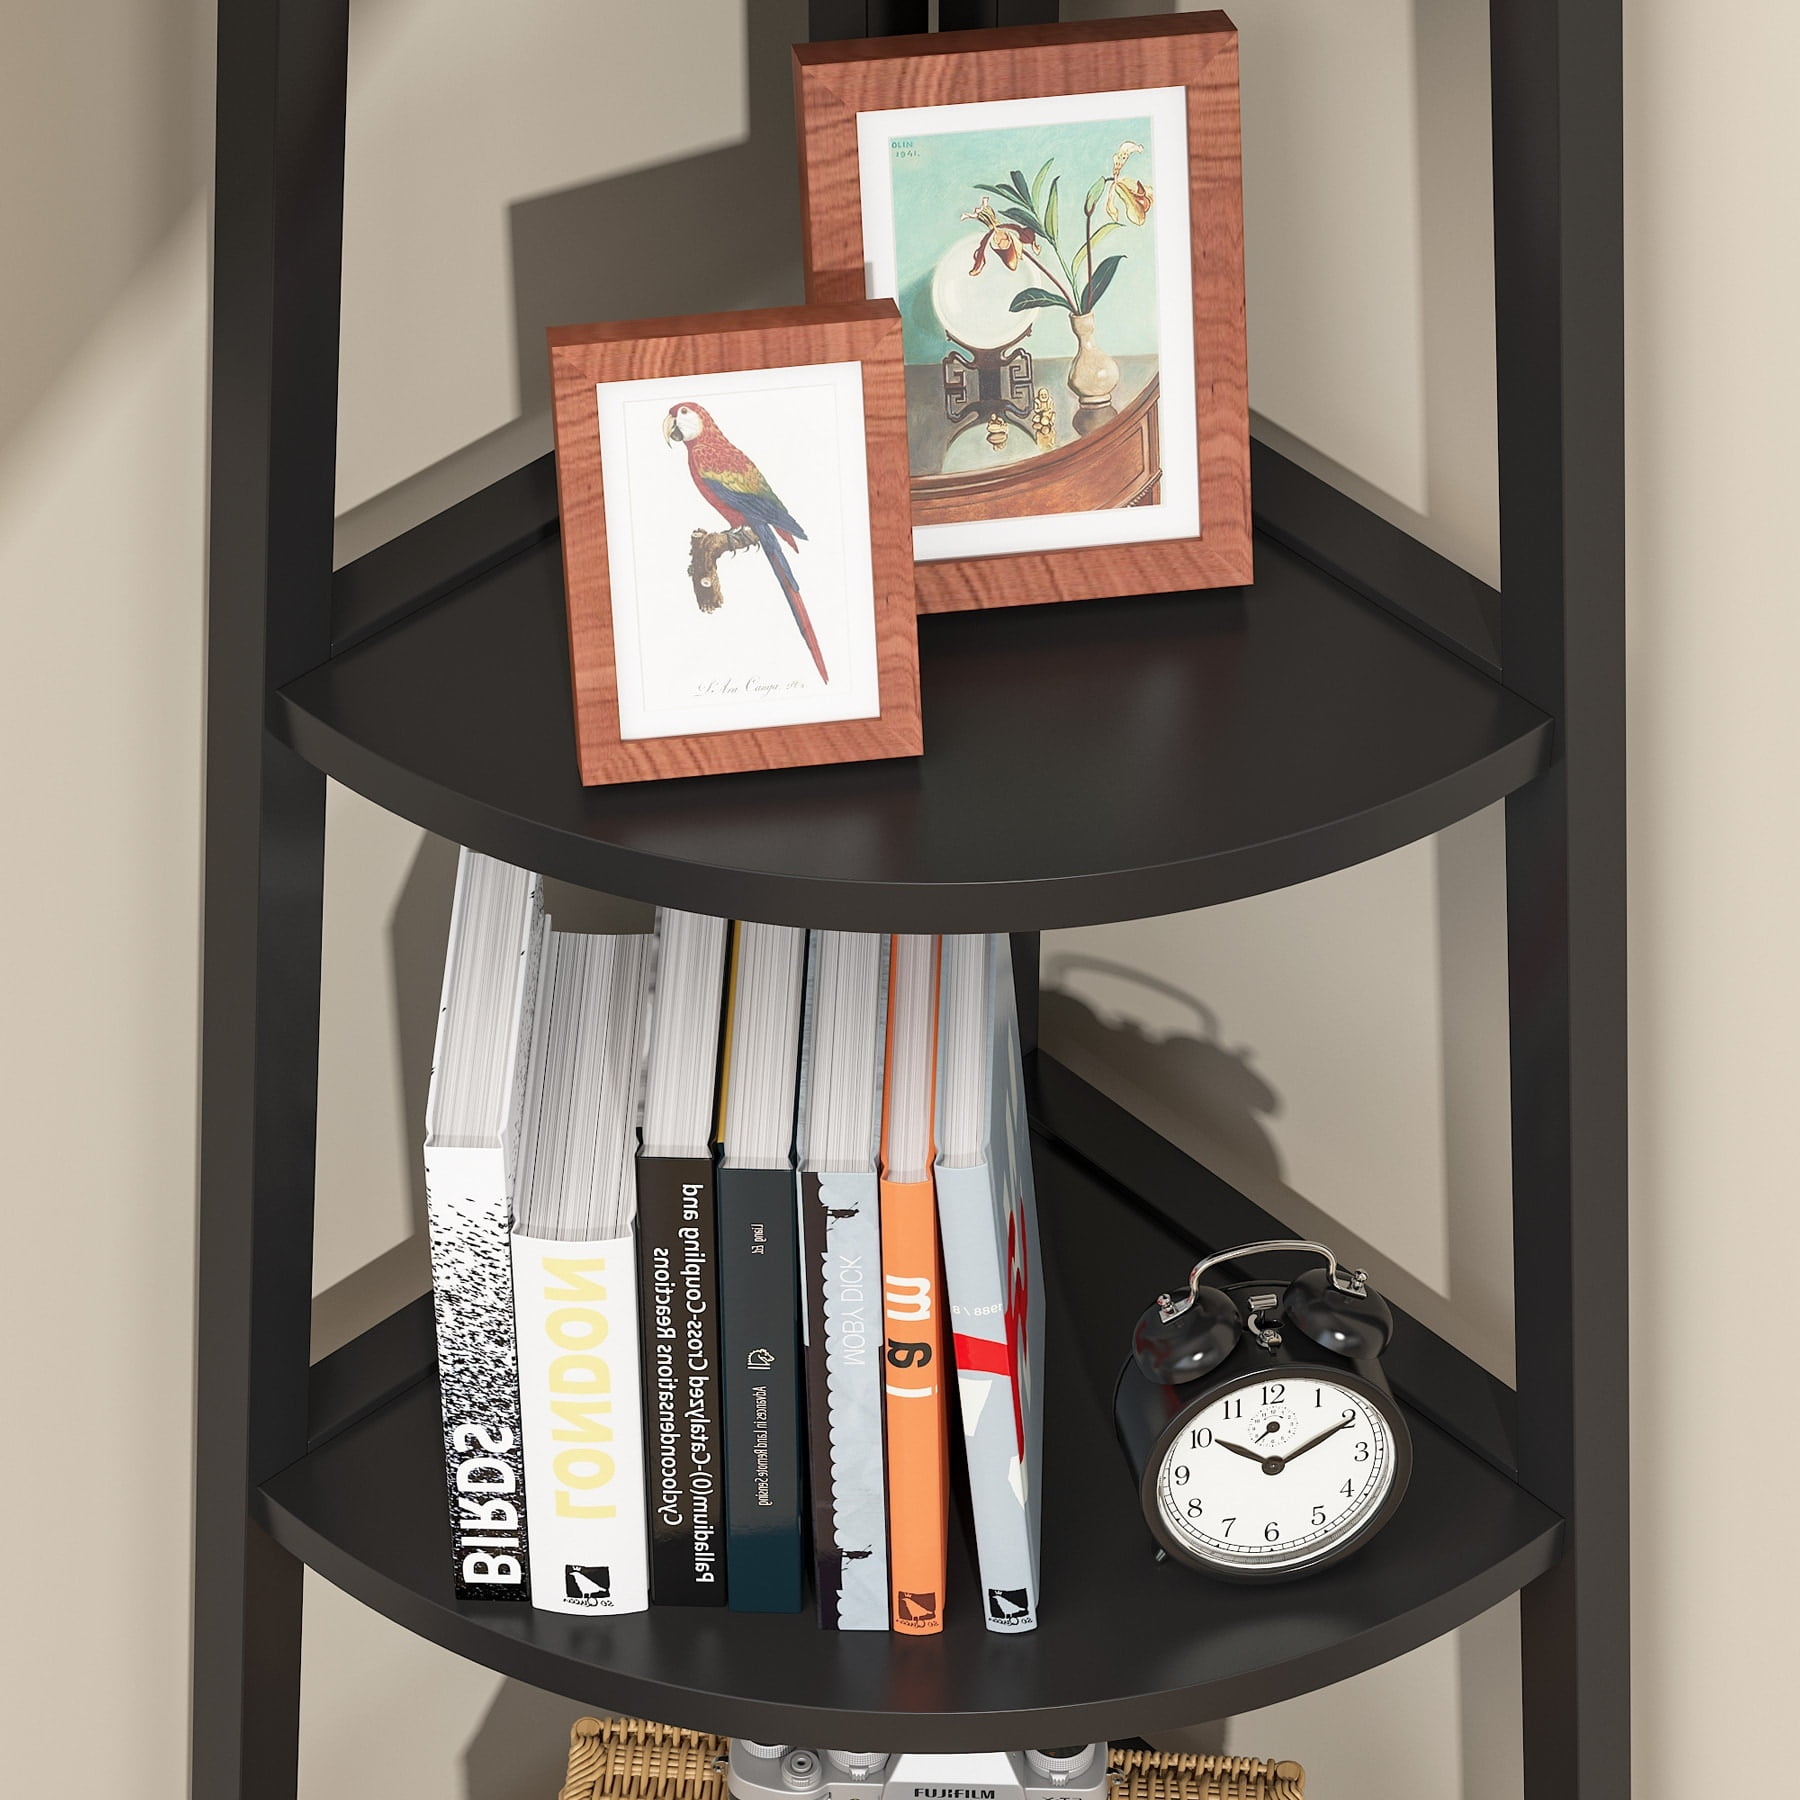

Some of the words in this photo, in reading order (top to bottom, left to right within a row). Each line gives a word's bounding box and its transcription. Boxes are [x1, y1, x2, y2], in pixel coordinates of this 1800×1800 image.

[1261, 1383, 1286, 1406] 12
[1314, 1388, 1322, 1408] 1
[1223, 1398, 1243, 1420] 11
[1340, 1408, 1357, 1429] 2
[1190, 1427, 1213, 1449] 10
[1353, 1441, 1369, 1461] 3
[1174, 1465, 1191, 1486] 9
[1339, 1478, 1355, 1498] 4
[1187, 1498, 1203, 1518] 8
[1311, 1505, 1326, 1526] 5
[1221, 1517, 1237, 1538] 7
[1264, 1522, 1280, 1542] 6
[914, 1788, 996, 1800] FUJIFILM
